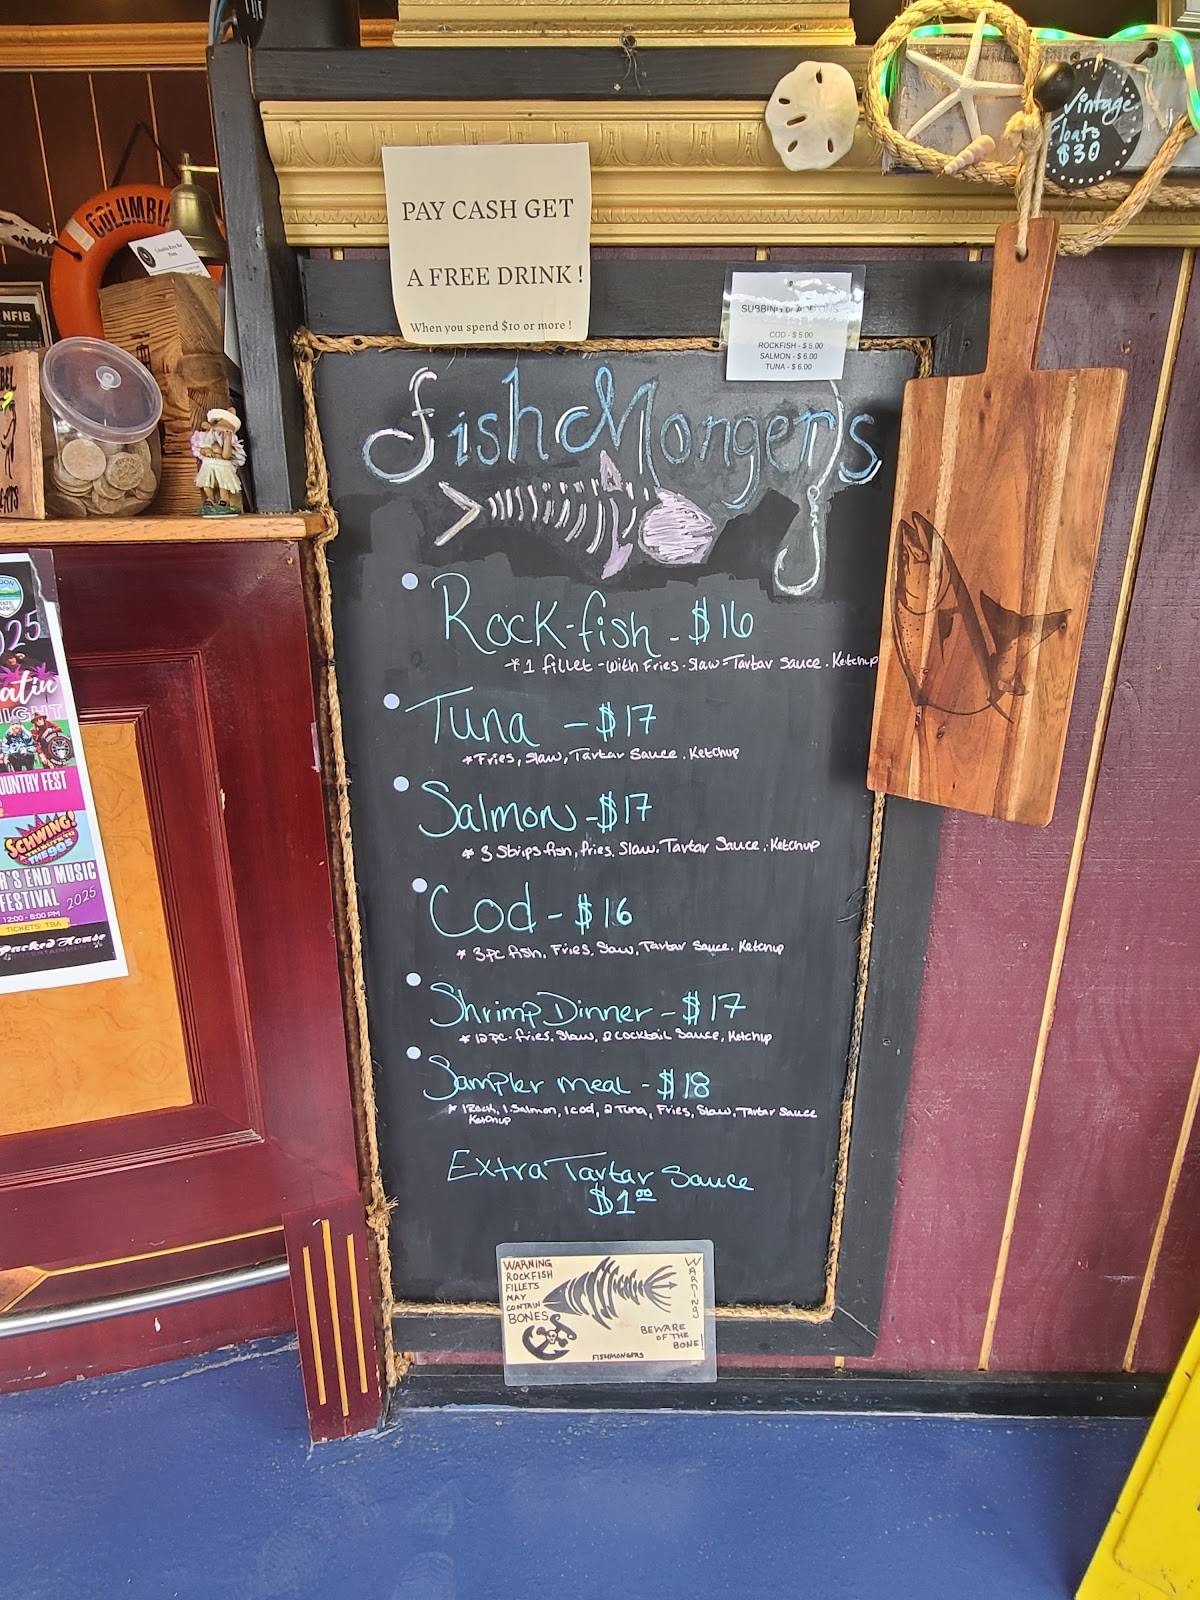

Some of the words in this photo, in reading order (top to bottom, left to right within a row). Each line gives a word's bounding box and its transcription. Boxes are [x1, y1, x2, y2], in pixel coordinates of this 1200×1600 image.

[1063, 86, 1137, 126] Vintage
[1056, 141, 1101, 167] $30
[402, 201, 446, 221] PAY
[452, 199, 518, 220] CASH
[524, 198, 574, 218] GET
[406, 268, 424, 287] A
[429, 267, 490, 286] FREE
[497, 265, 572, 285] DRINK
[2, 310, 32, 321] NFIB
[410, 322, 442, 333] When
[445, 324, 464, 335] you
[466, 321, 499, 336] spend
[502, 322, 520, 332] $10
[538, 322, 566, 330] more
[760, 352, 790, 360] SALMON
[689, 596, 754, 645] $16
[542, 654, 593, 674] fillet
[405, 686, 541, 747] Tuna
[596, 702, 656, 742] $17
[569, 748, 625, 762] Tartar
[689, 747, 740, 760] Ketchup
[41, 770, 67, 792] FEST
[418, 780, 577, 837] Salmon
[597, 791, 652, 833] $17
[4, 810, 77, 859] SCHWING!
[496, 843, 541, 860] Strips
[659, 837, 710, 854] Tartar
[23, 866, 52, 887] END
[53, 861, 97, 884] MUSIC
[0, 888, 60, 912] FESTIVAL
[66, 886, 97, 910] 2025
[47, 910, 60, 918] PM
[430, 882, 536, 937] Cod
[575, 893, 633, 935] $16
[639, 940, 686, 952] Tartar
[430, 982, 542, 1028] Shrimp
[536, 991, 653, 1026] Dinner
[682, 991, 746, 1025] $17
[423, 1054, 545, 1101] Sampler
[557, 1076, 631, 1095] meal
[657, 1068, 710, 1100] $18
[779, 1106, 818, 1118] Sauce
[447, 1149, 548, 1182] Extra
[543, 1151, 654, 1186] Tartar
[661, 1165, 755, 1191] Sauce
[503, 1258, 553, 1270] WARNING
[506, 1270, 553, 1281] ROCKFISH
[505, 1282, 540, 1292] FILLETS
[506, 1293, 526, 1301] MAY
[506, 1301, 541, 1311] CONTAIN
[508, 1311, 549, 1325] BONES
[640, 1323, 686, 1334] BEWARE
[670, 1332, 689, 1340] THE
[592, 1351, 645, 1361] FISHMONGERS
